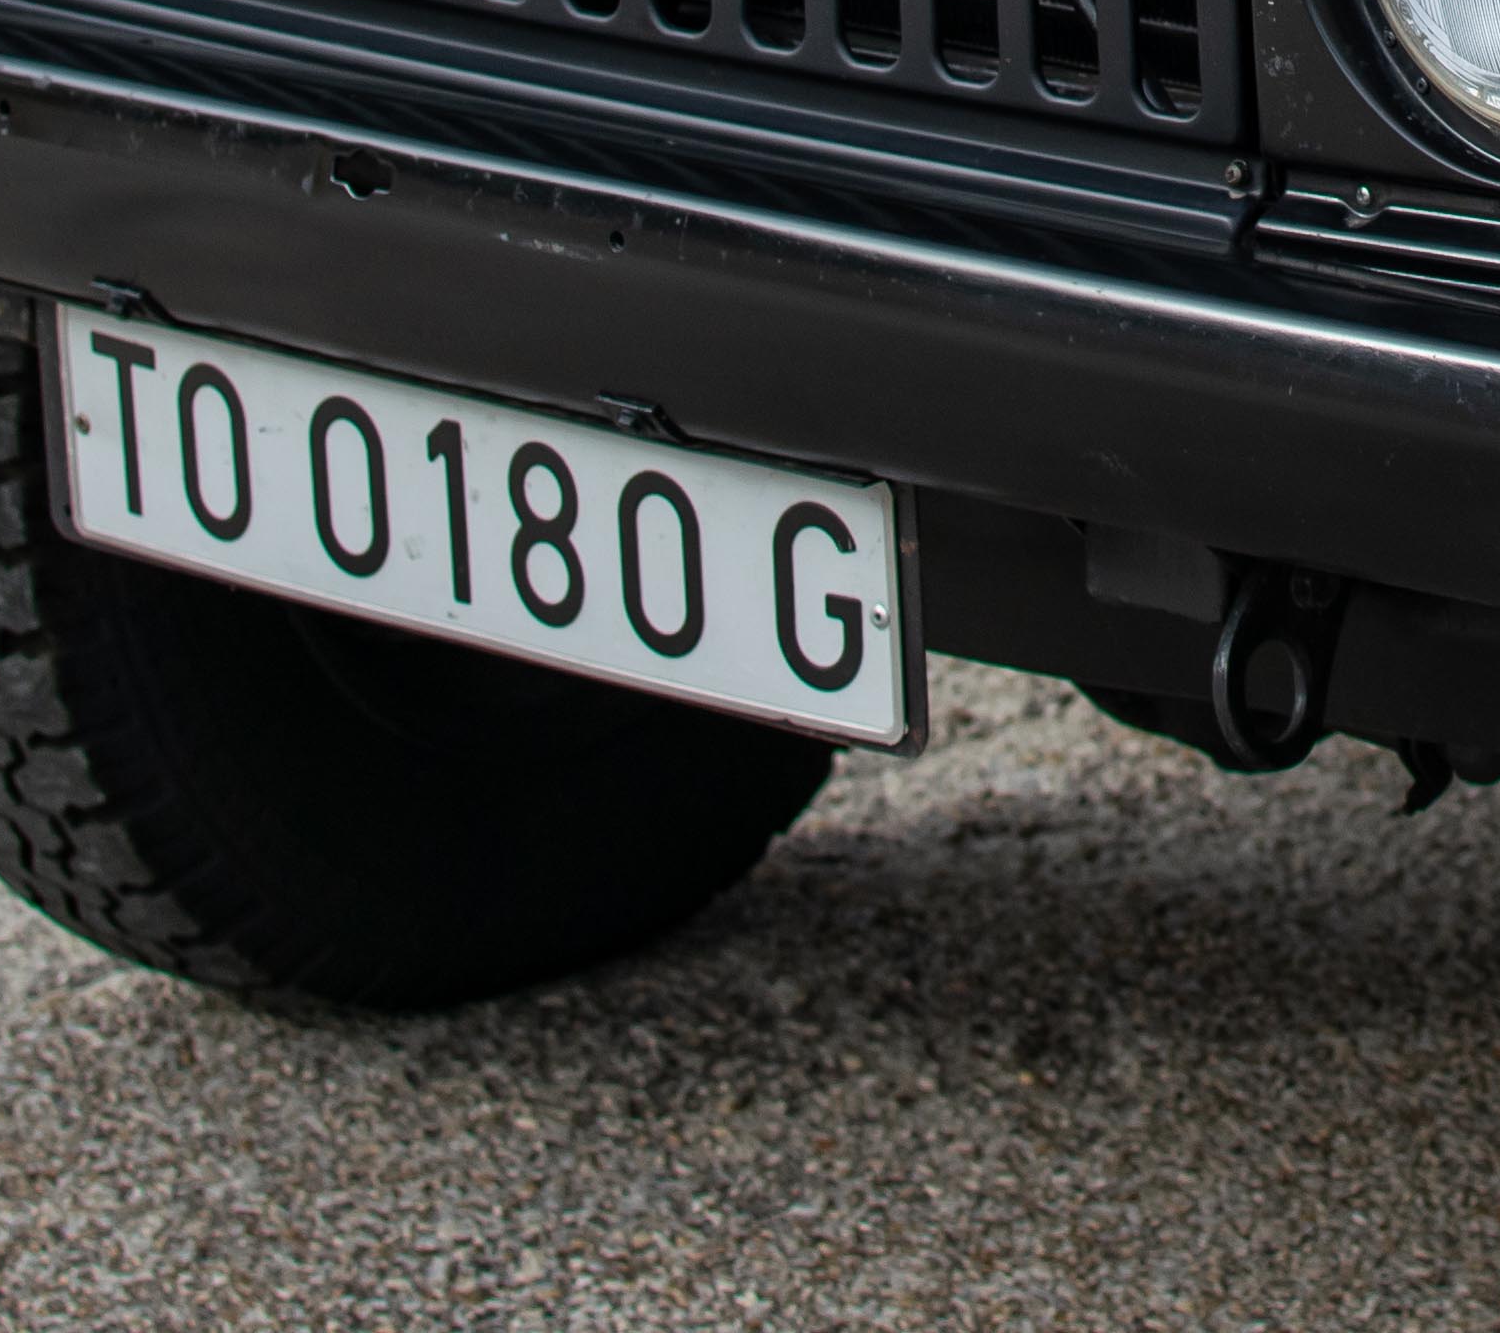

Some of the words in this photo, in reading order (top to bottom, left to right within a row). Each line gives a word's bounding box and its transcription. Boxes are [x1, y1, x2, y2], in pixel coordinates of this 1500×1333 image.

[90, 331, 253, 542] TO
[309, 394, 706, 659] 0180
[772, 500, 864, 692] G
